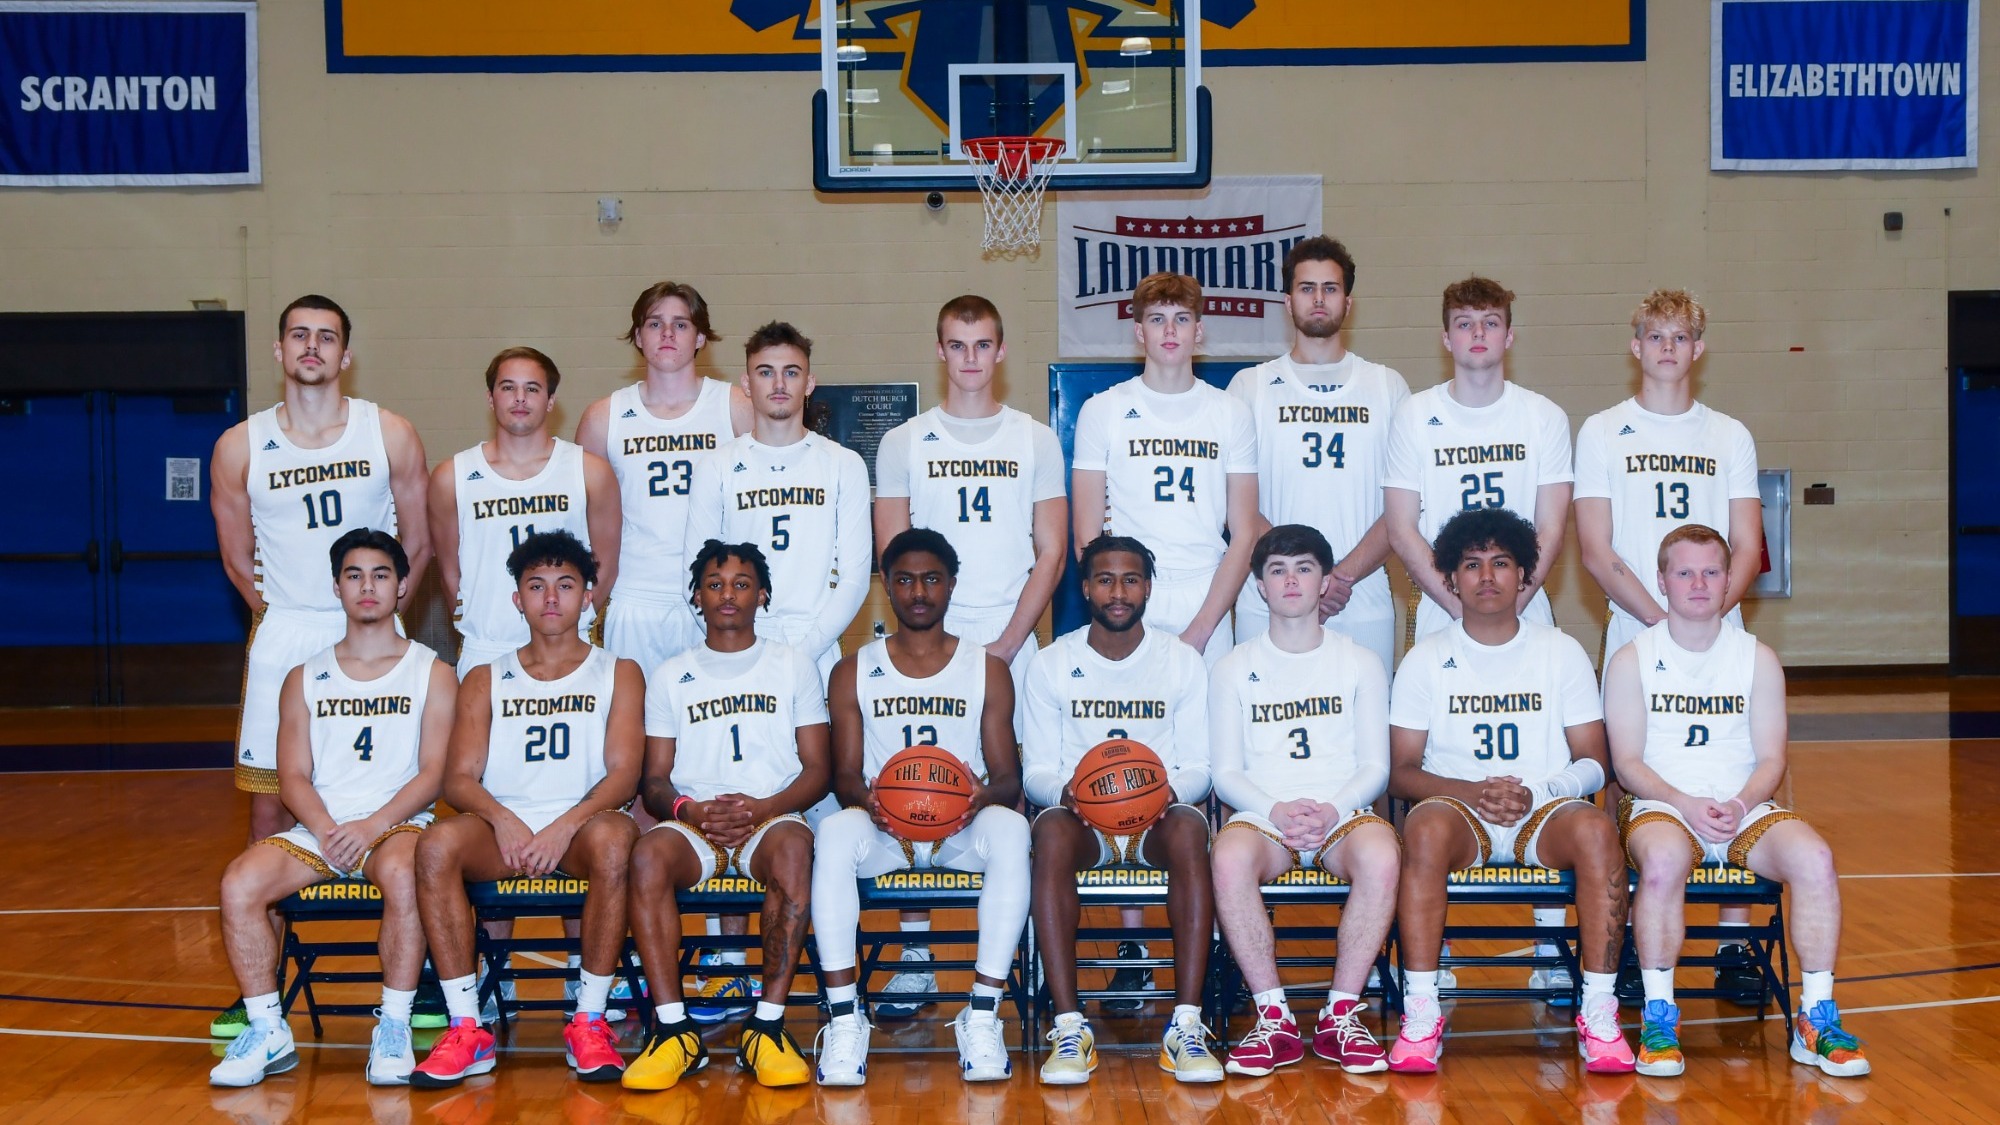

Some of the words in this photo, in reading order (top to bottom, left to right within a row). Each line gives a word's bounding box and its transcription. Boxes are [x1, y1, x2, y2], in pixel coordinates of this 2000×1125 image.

[1729, 62, 1961, 98] ELIZABETHTOWN
[20, 76, 216, 111] SCRANTON
[1125, 300, 1257, 314] CENCE
[1278, 405, 1370, 424] LYCOMING
[623, 433, 717, 456] LYCOMING
[1128, 438, 1219, 460] LYCOMING
[1302, 431, 1345, 469] 34
[1434, 443, 1526, 467] LYCOMING
[268, 459, 371, 490] LYCOMING
[927, 459, 1019, 479] LYCOMING
[1625, 453, 1717, 477] LYCOMING
[647, 459, 693, 498] 23
[1153, 465, 1196, 503] 24
[1460, 471, 1505, 510] 25
[302, 489, 343, 530] 10
[472, 494, 569, 521] LYCOMING
[736, 486, 825, 511] LYCOMING
[957, 486, 992, 523] 14
[1655, 481, 1690, 520] 13
[771, 514, 791, 552] 5
[316, 695, 412, 718] LYCOMING
[502, 694, 596, 718] LYCOMING
[687, 693, 777, 724] LYCOMING
[872, 696, 967, 718] LYCOMING
[1071, 699, 1166, 719] LYCOMING
[1251, 695, 1343, 723] LYCOMING
[1448, 692, 1542, 714] LYCOMING
[1650, 693, 1745, 715] LYCOMING
[352, 725, 374, 762] 4
[524, 722, 570, 763] 20
[730, 723, 743, 762] 1
[1288, 727, 1311, 760] 3
[1472, 722, 1520, 761] 30
[895, 762, 922, 781] THE
[928, 763, 960, 787] ROCK
[1089, 772, 1119, 797] THE
[1123, 767, 1158, 791] ROCK
[910, 812, 937, 821] ROCK
[1118, 815, 1144, 827] ROCK
[495, 879, 589, 894] WARRIOR
[875, 873, 983, 889] WARRIORS
[1450, 867, 1560, 884] WARRIORS
[299, 884, 382, 900] WARRIO
